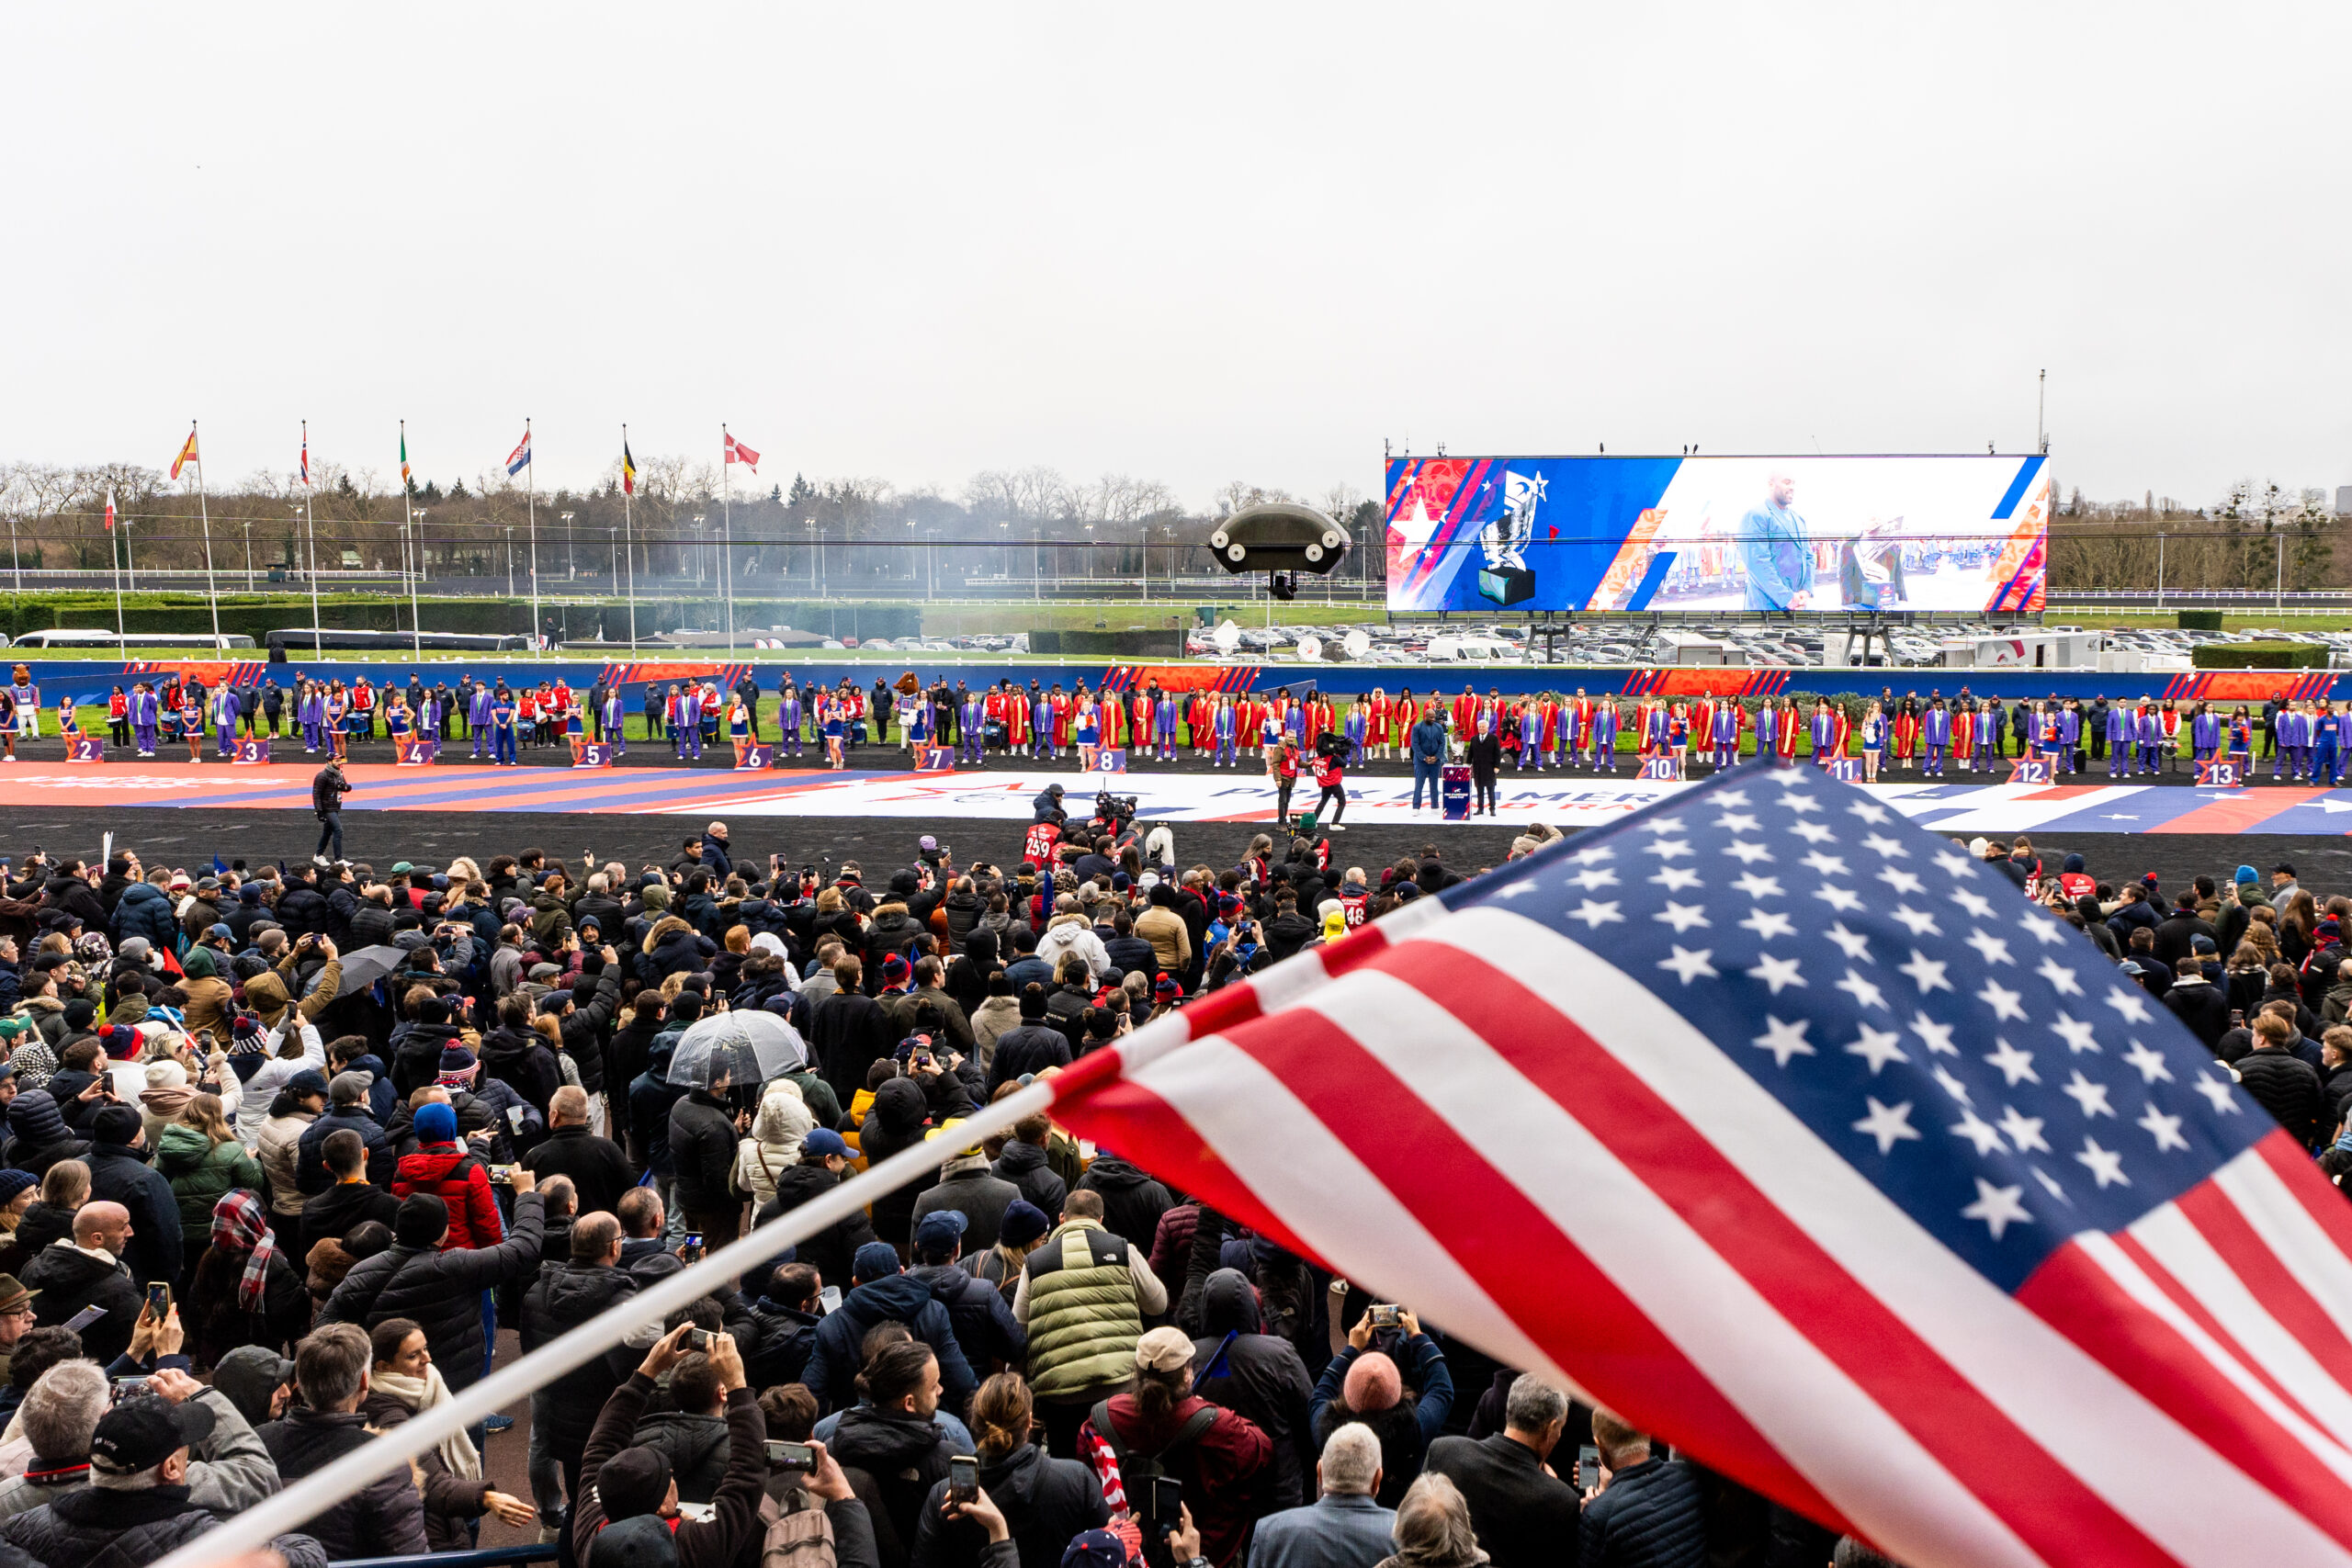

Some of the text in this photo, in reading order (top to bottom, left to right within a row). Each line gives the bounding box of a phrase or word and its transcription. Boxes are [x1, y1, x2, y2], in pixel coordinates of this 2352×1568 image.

[80, 740, 92, 760] 2
[245, 742, 258, 761] 3
[410, 744, 423, 763] 4
[587, 745, 600, 765] 5
[749, 748, 762, 767] 6
[929, 749, 943, 769] 7
[1100, 751, 1114, 772] 8
[1647, 759, 1671, 779] 10
[1832, 760, 1853, 781] 11
[2019, 762, 2043, 783] 12
[2209, 763, 2233, 784] 13
[1025, 837, 1050, 859] 259
[1346, 907, 1365, 926] 48
